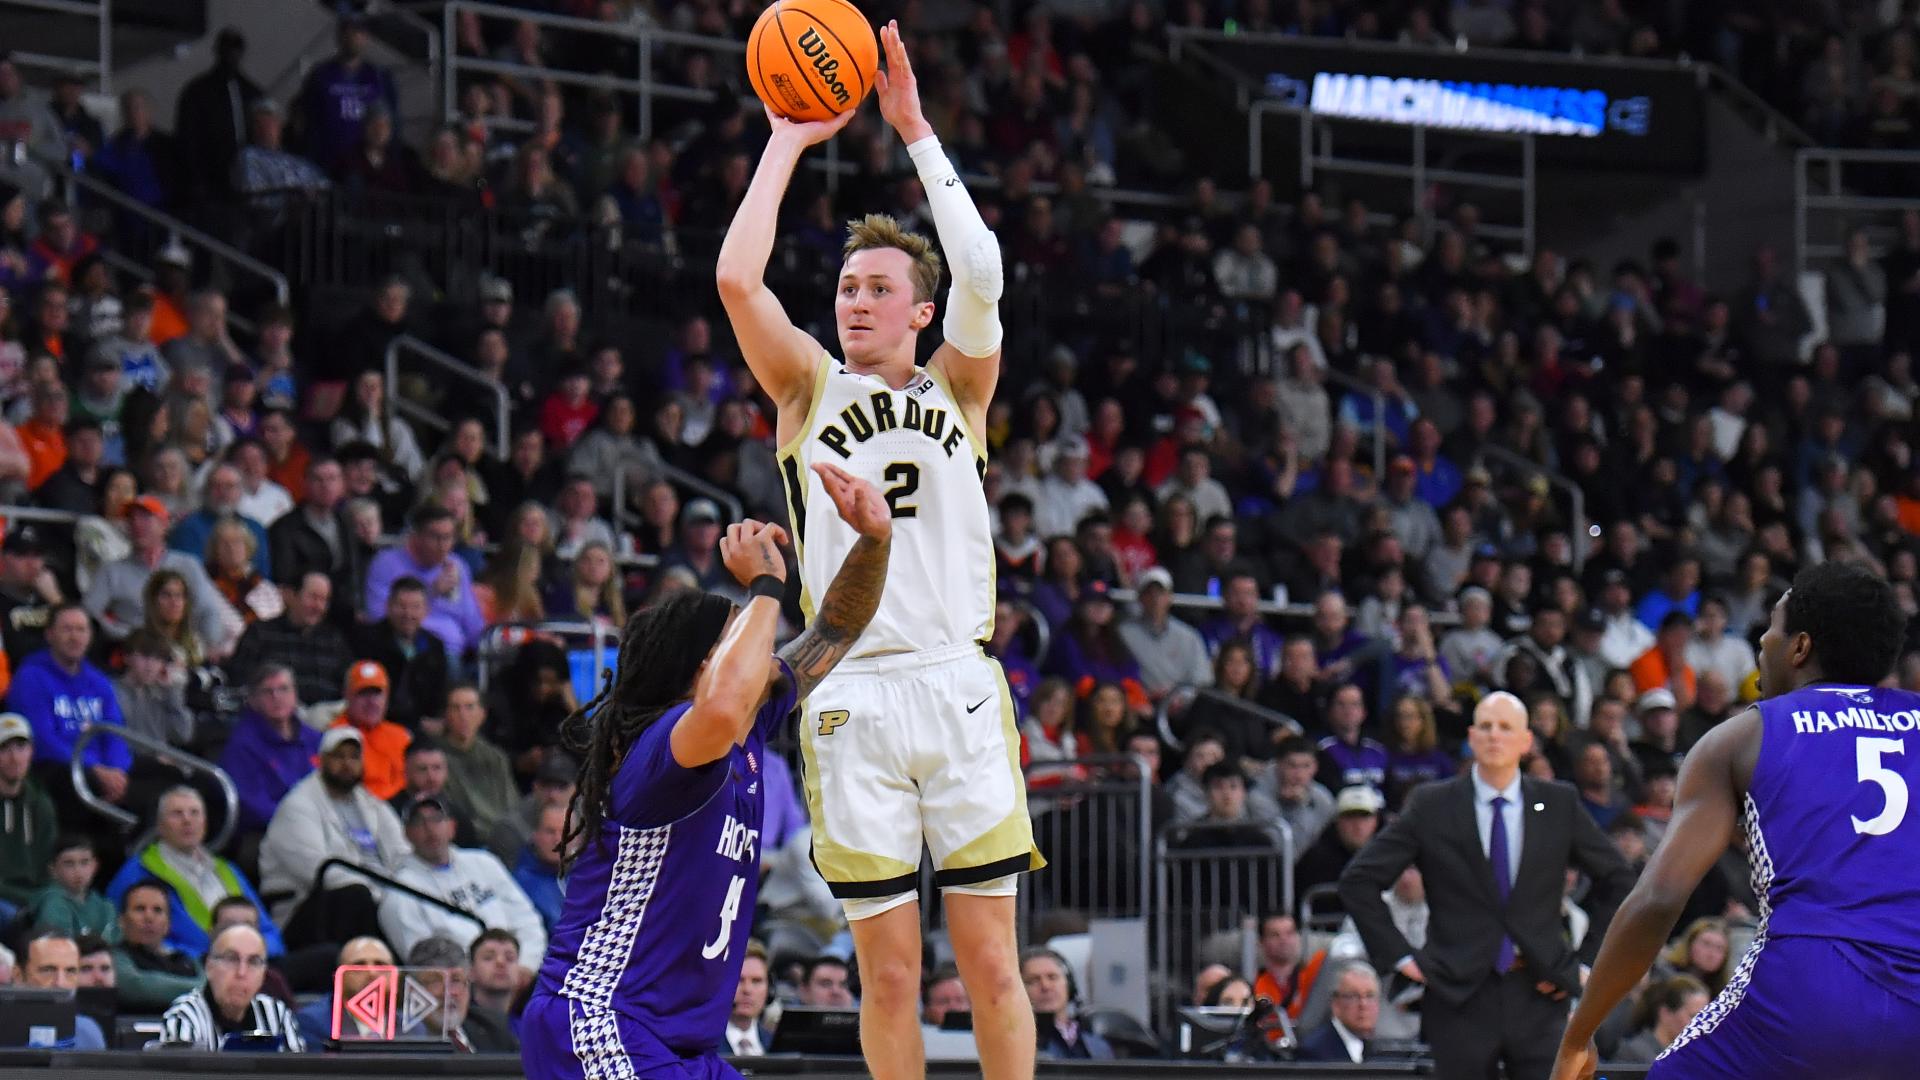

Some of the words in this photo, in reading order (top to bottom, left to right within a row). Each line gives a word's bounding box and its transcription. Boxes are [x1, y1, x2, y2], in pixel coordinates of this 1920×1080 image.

[798, 26, 851, 106] Wilson
[818, 391, 965, 460] PURDUE
[884, 461, 920, 519] 2
[818, 709, 850, 736] P
[1850, 736, 1909, 835] 5
